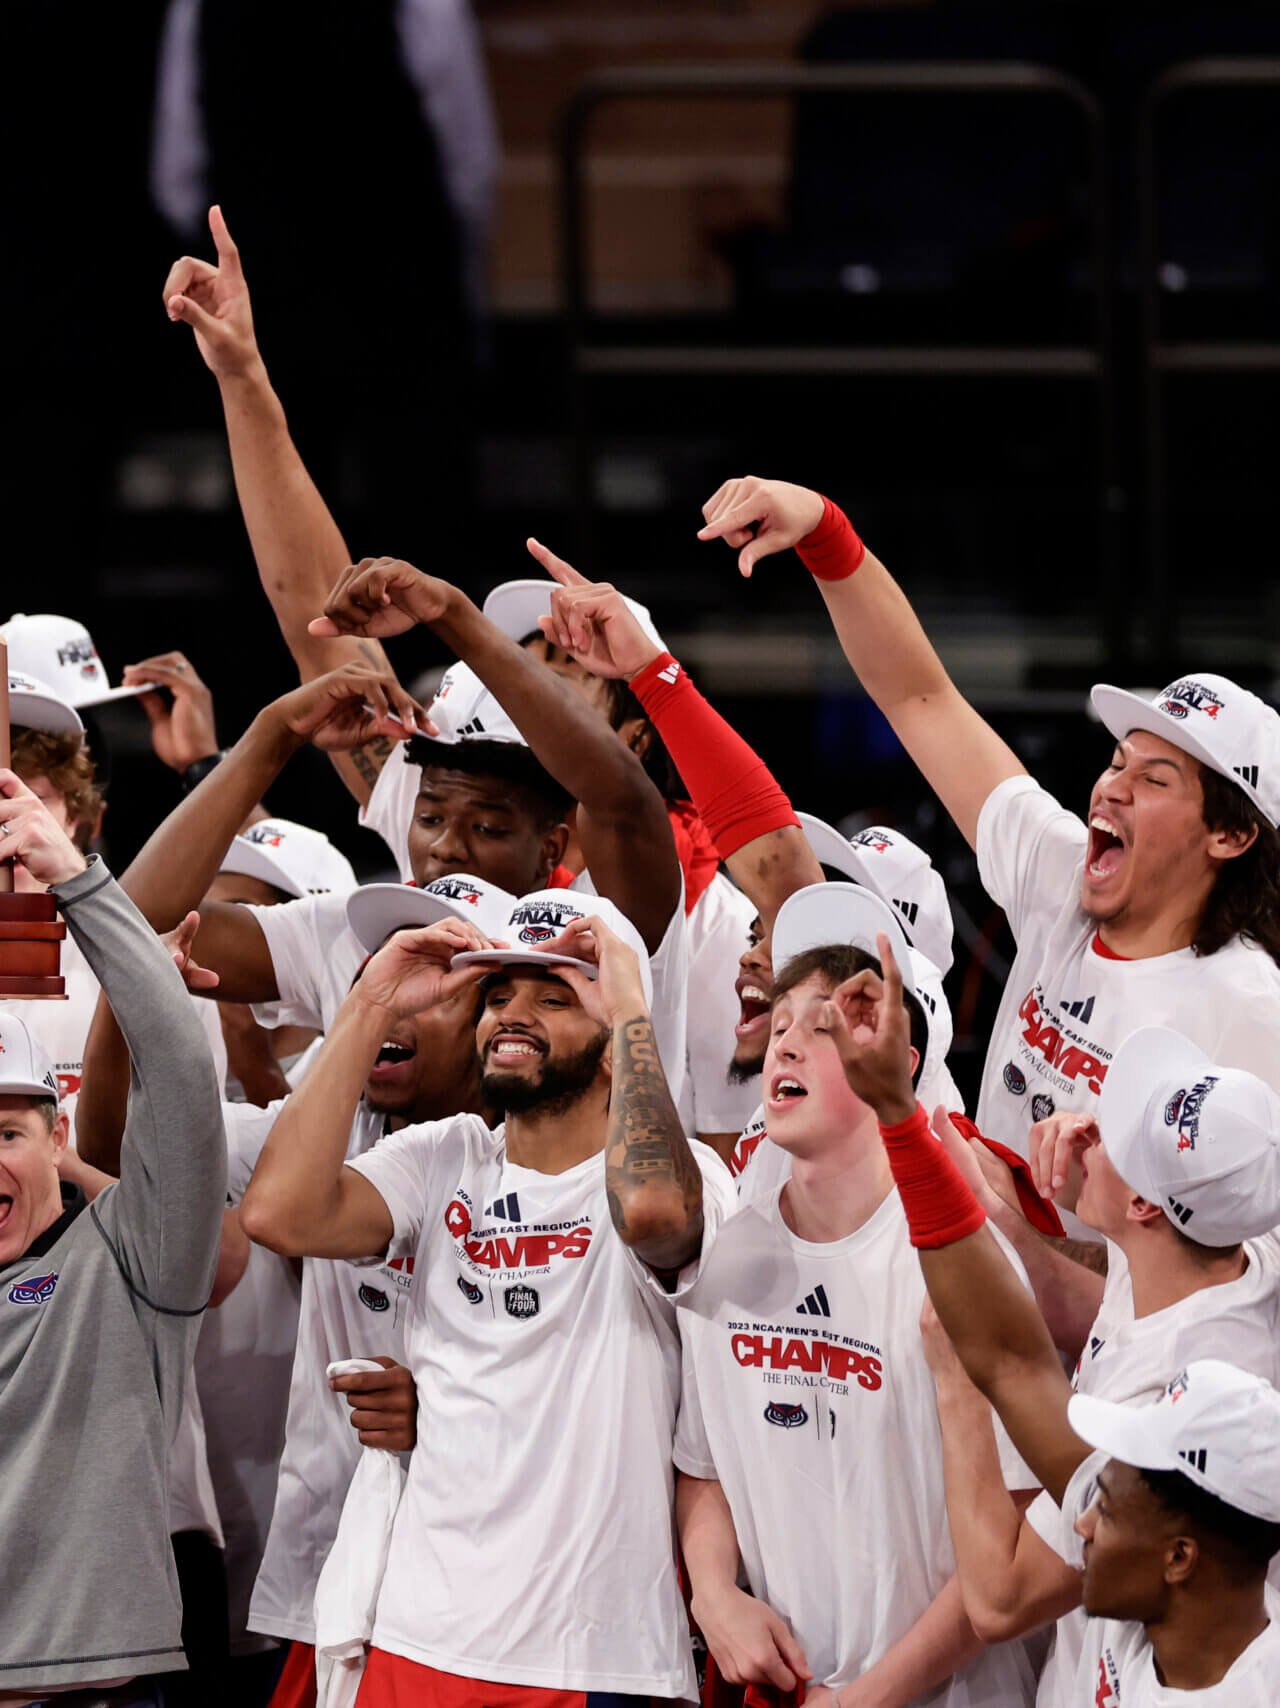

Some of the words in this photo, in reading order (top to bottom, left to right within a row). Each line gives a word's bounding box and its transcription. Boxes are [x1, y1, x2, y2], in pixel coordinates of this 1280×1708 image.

[508, 910, 566, 928] FINAL
[1177, 1133, 1191, 1151] 4
[500, 1225, 530, 1235] EAST
[532, 1215, 592, 1232] REGIONAL
[510, 1291, 534, 1301] FINAL
[512, 1300, 537, 1312] FOUR
[728, 1321, 750, 1331] 2023
[785, 1326, 819, 1338] MEN'S
[731, 1333, 883, 1391] CHAMPS
[763, 1372, 782, 1385] THE
[784, 1374, 819, 1388] FINAL
[819, 1376, 849, 1396] CTER
